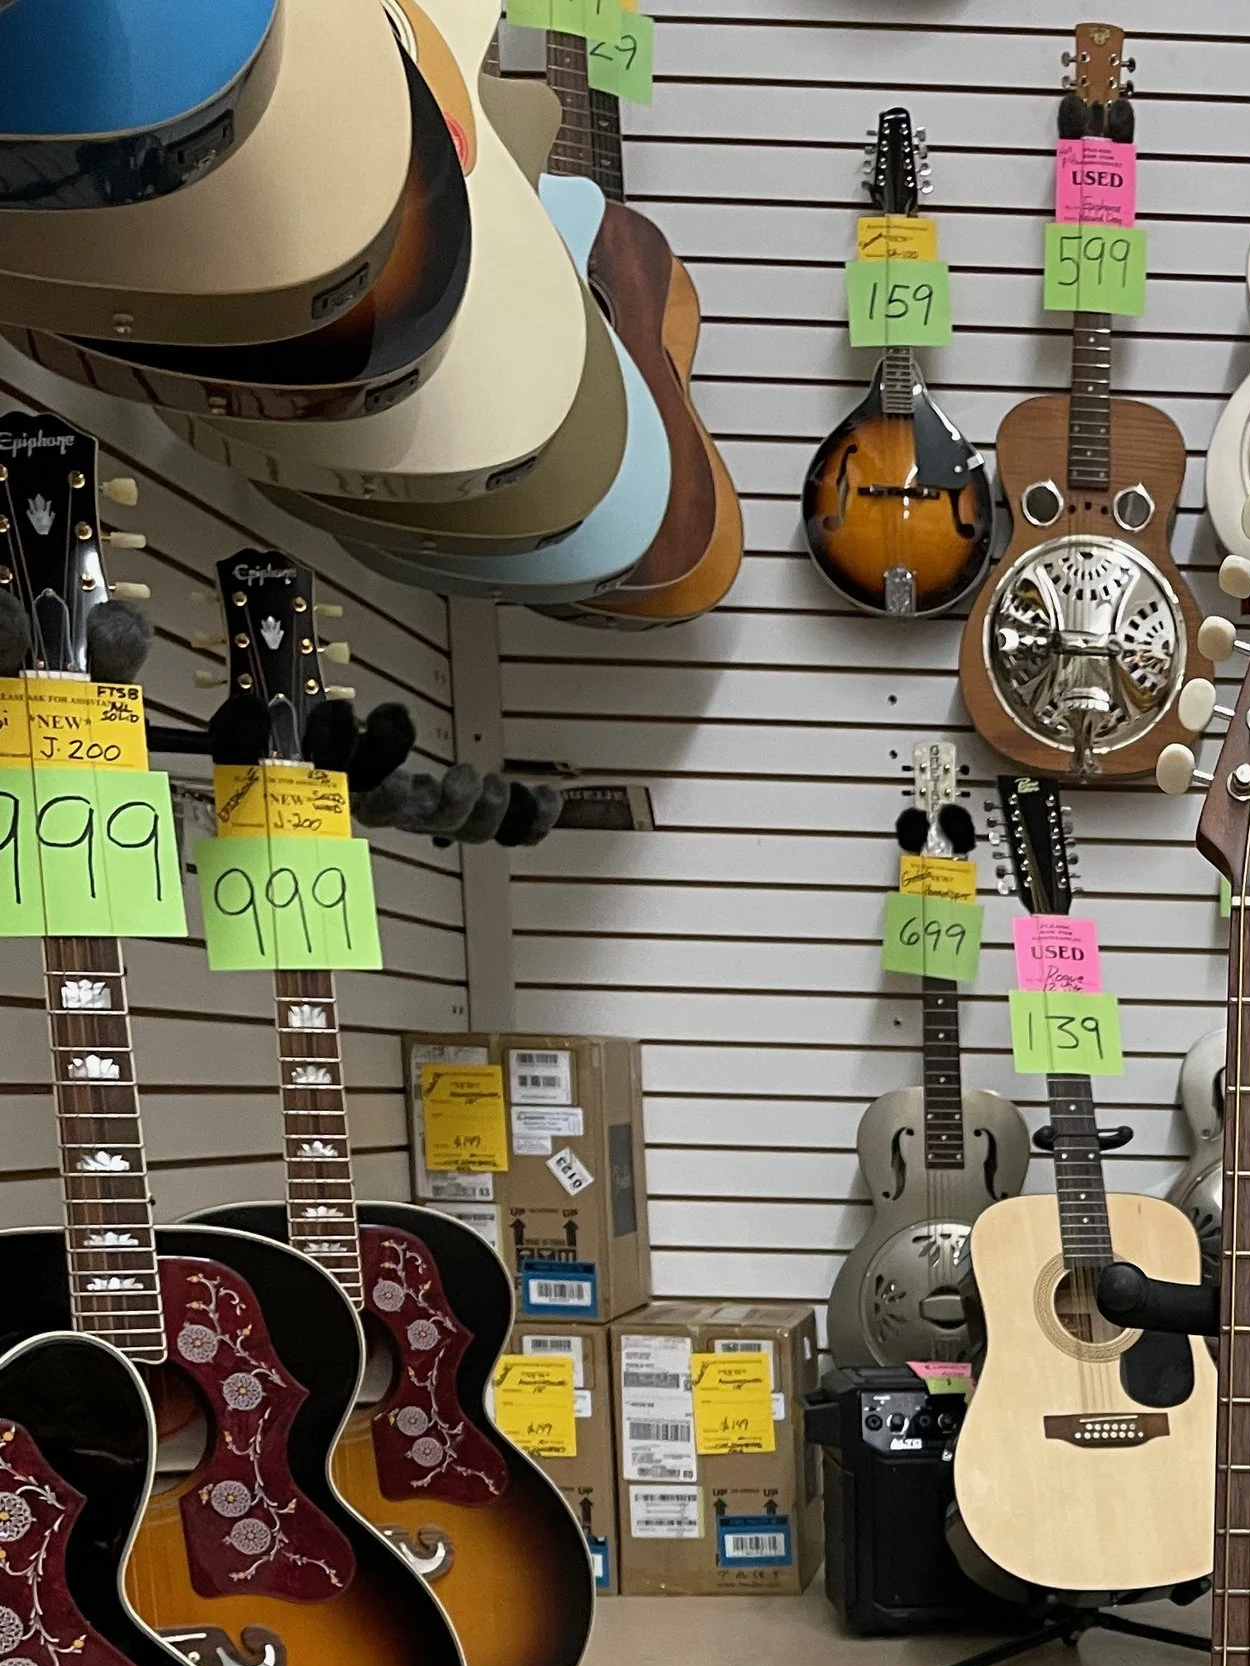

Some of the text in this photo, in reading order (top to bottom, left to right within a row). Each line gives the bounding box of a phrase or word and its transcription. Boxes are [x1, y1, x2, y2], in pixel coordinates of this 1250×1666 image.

[1071, 170, 1124, 188] USED
[1057, 235, 1131, 288] 599
[868, 282, 933, 326] 159
[0, 429, 75, 458] Epiphone
[214, 867, 352, 956] 999
[899, 917, 967, 956] 699
[1031, 945, 1085, 961] USED
[1028, 1012, 1104, 1060] 139
